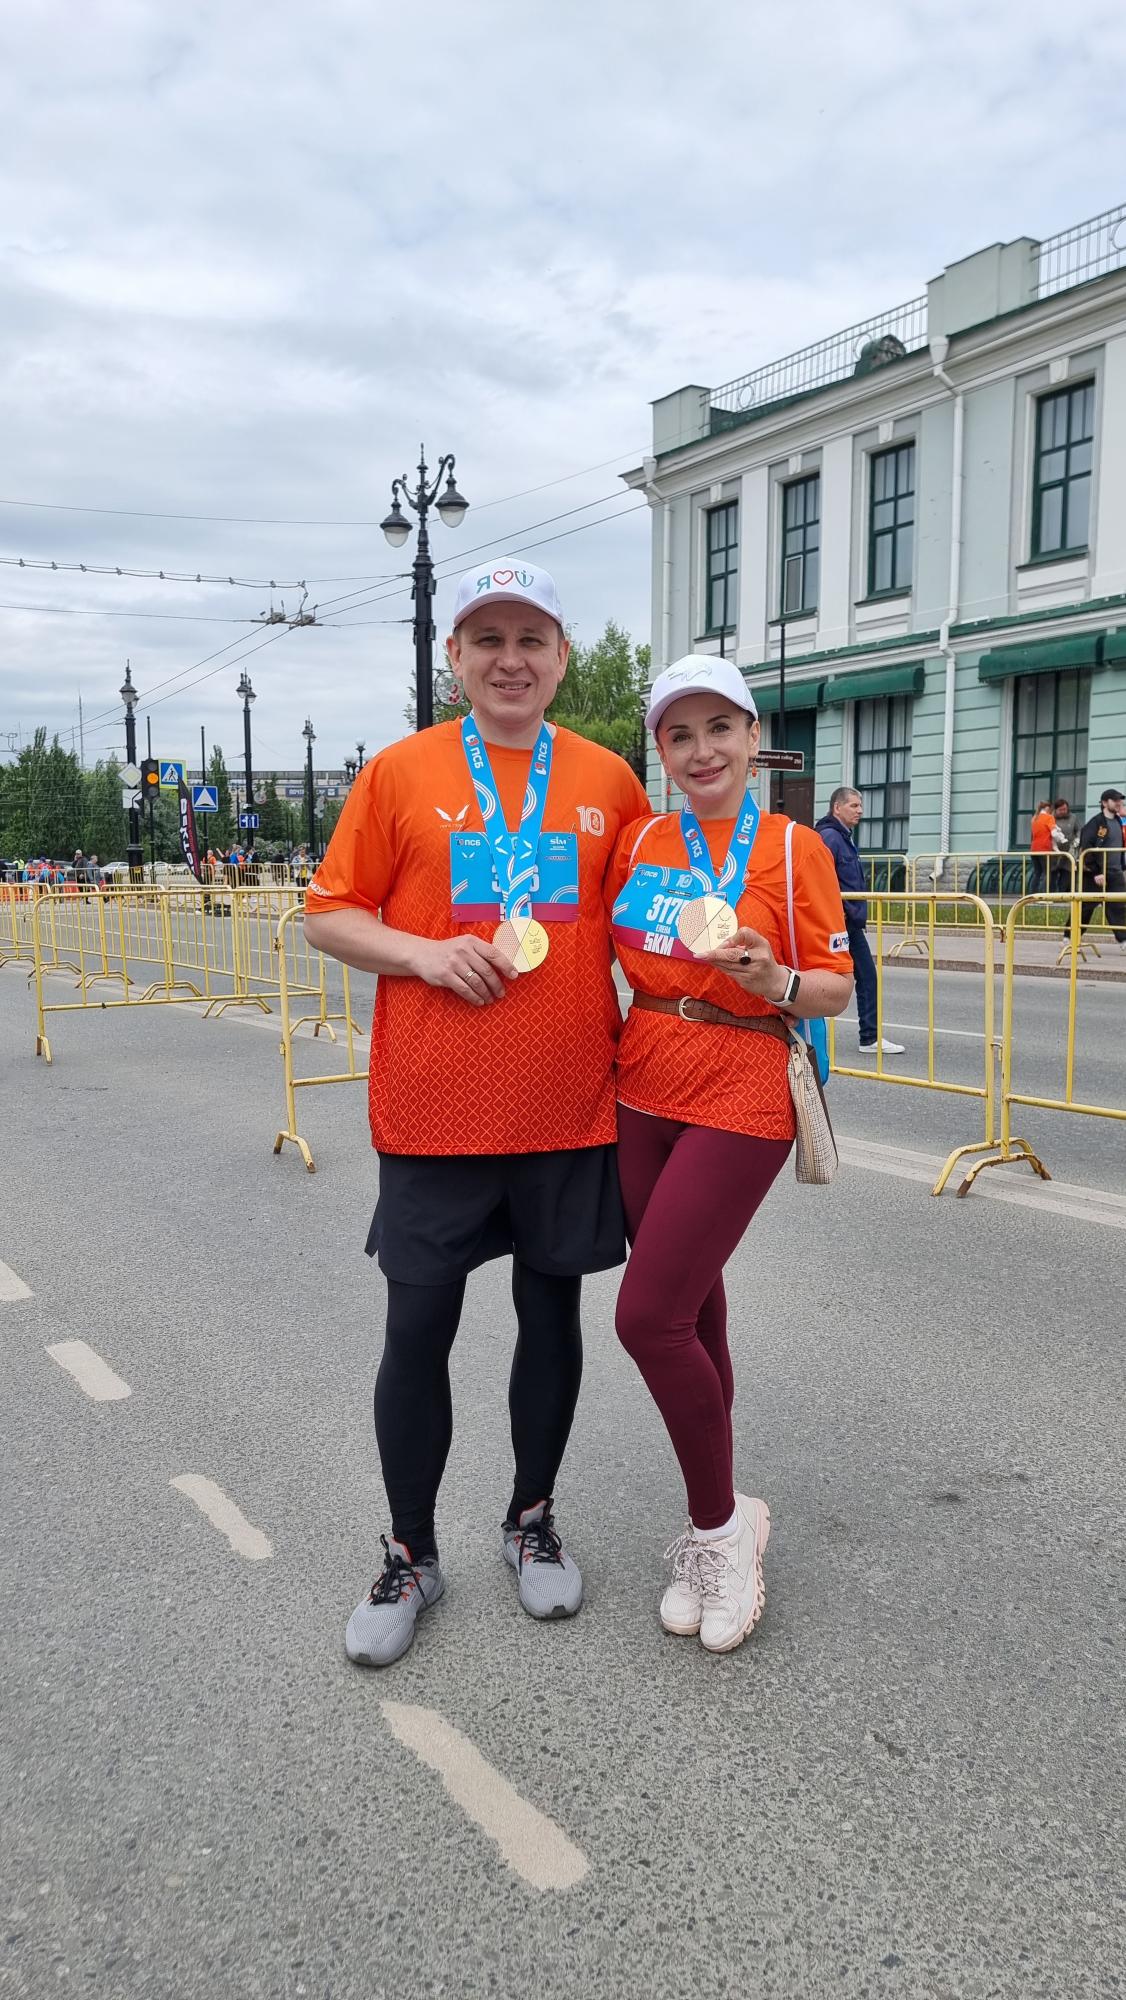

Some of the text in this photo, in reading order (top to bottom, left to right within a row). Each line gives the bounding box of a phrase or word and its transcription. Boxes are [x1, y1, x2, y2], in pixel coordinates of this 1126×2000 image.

[470, 746, 485, 769] ПСБ
[537, 741, 548, 763] ПСБ
[575, 805, 605, 837] 10
[741, 812, 754, 834] ПСБ
[464, 839, 481, 847] ПСБ
[690, 839, 703, 858] ПСБ
[645, 870, 659, 878] ПСБ
